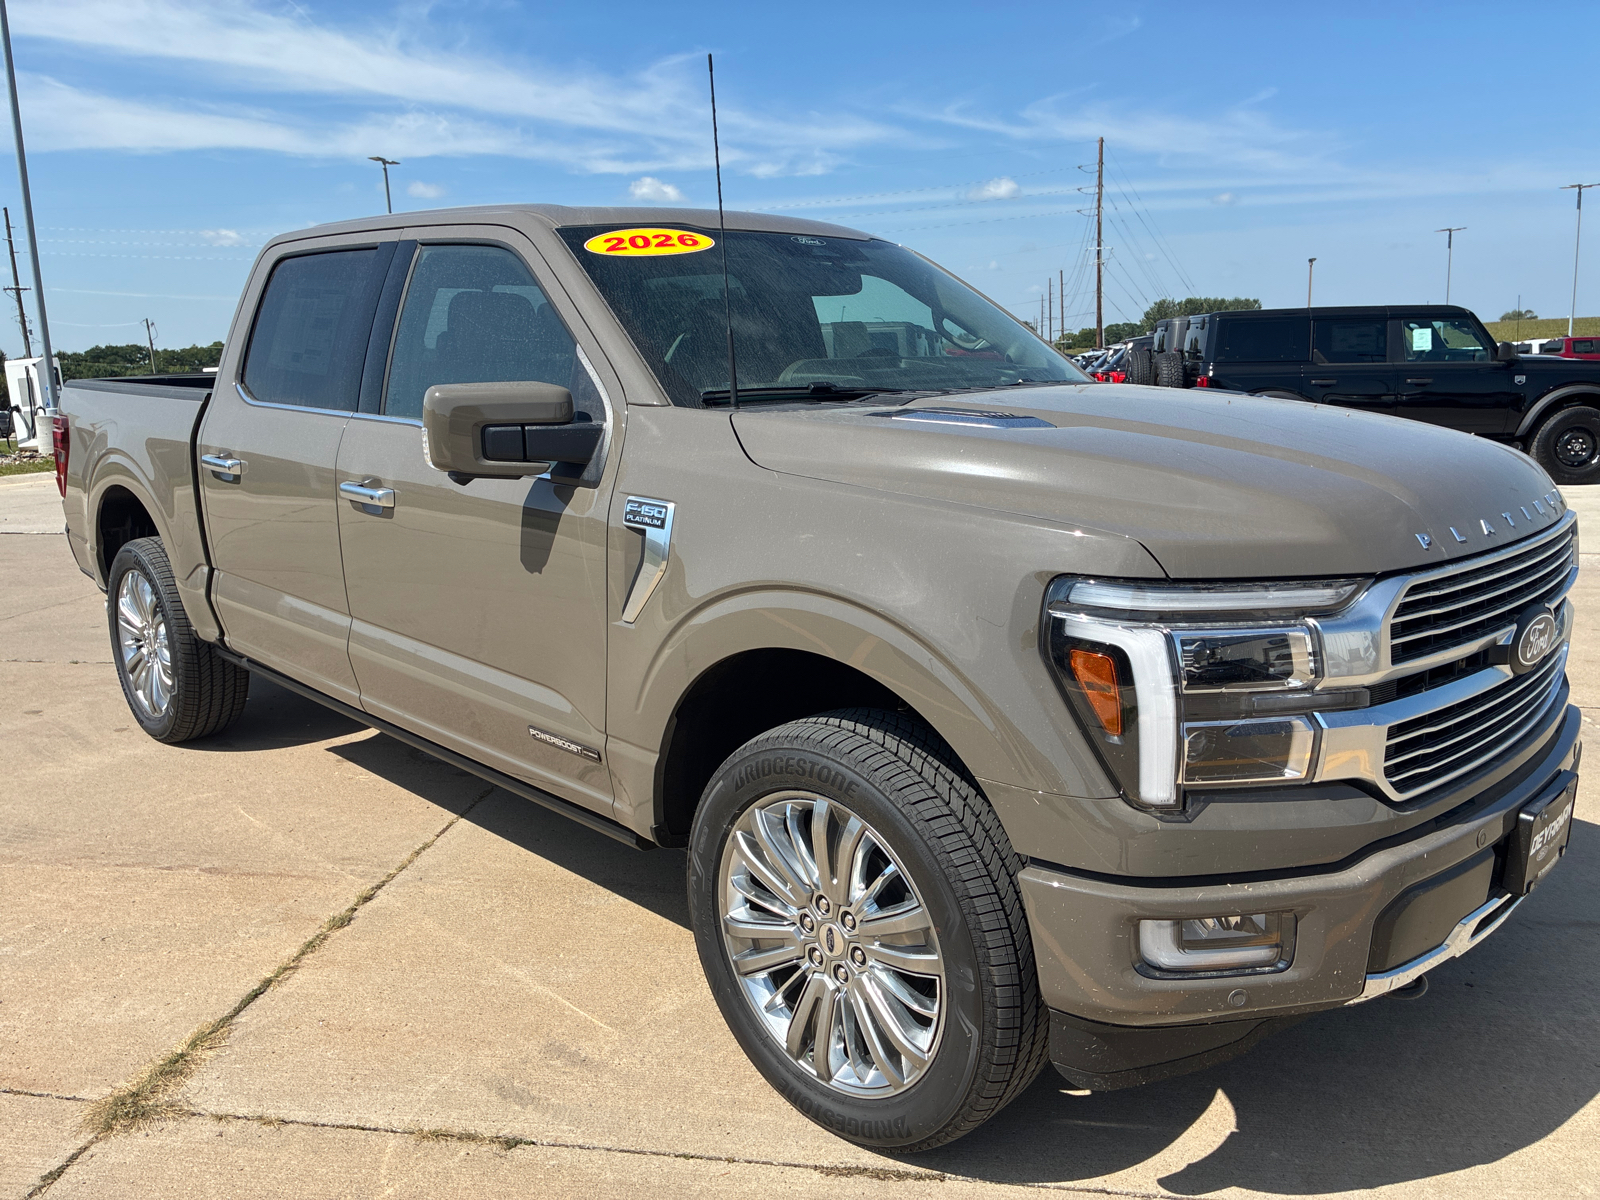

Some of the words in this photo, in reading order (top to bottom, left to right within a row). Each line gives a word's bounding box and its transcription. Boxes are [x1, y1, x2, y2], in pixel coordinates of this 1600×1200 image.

[603, 233, 700, 252] 2026
[626, 502, 666, 518] F-150
[626, 514, 661, 526] PLATINUM
[1527, 621, 1551, 659] Ford
[529, 728, 582, 754] POWERBOOST
[733, 755, 861, 799] BRIDGESTONE
[776, 1077, 914, 1140] BRIDGESTONE
